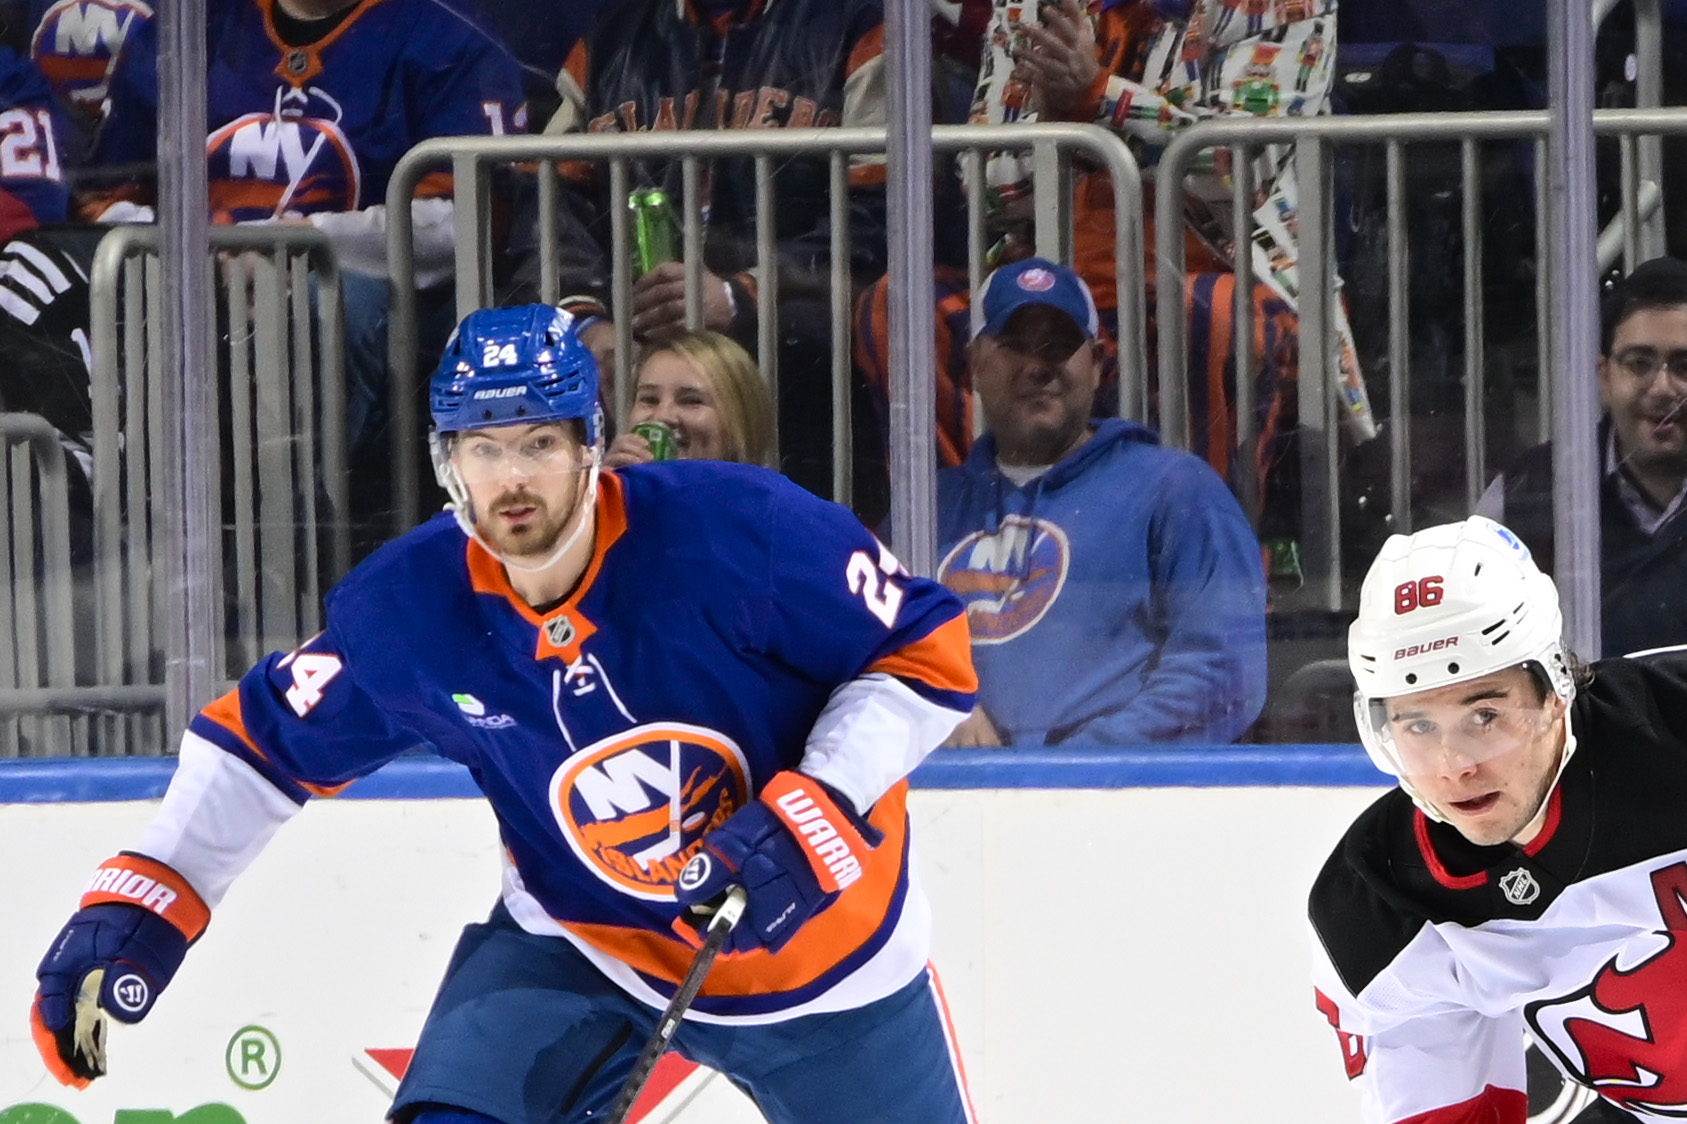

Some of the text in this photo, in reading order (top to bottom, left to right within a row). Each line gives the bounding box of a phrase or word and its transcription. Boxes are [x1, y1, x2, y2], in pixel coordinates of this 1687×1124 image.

[0, 107, 61, 182] 21
[229, 119, 327, 195] NY
[473, 385, 528, 400] BAUER
[483, 343, 518, 369] 24
[846, 547, 912, 630] 2
[1394, 575, 1444, 616] 86
[280, 640, 343, 719] 4
[1394, 636, 1459, 661] BAUER
[574, 739, 681, 838] NY
